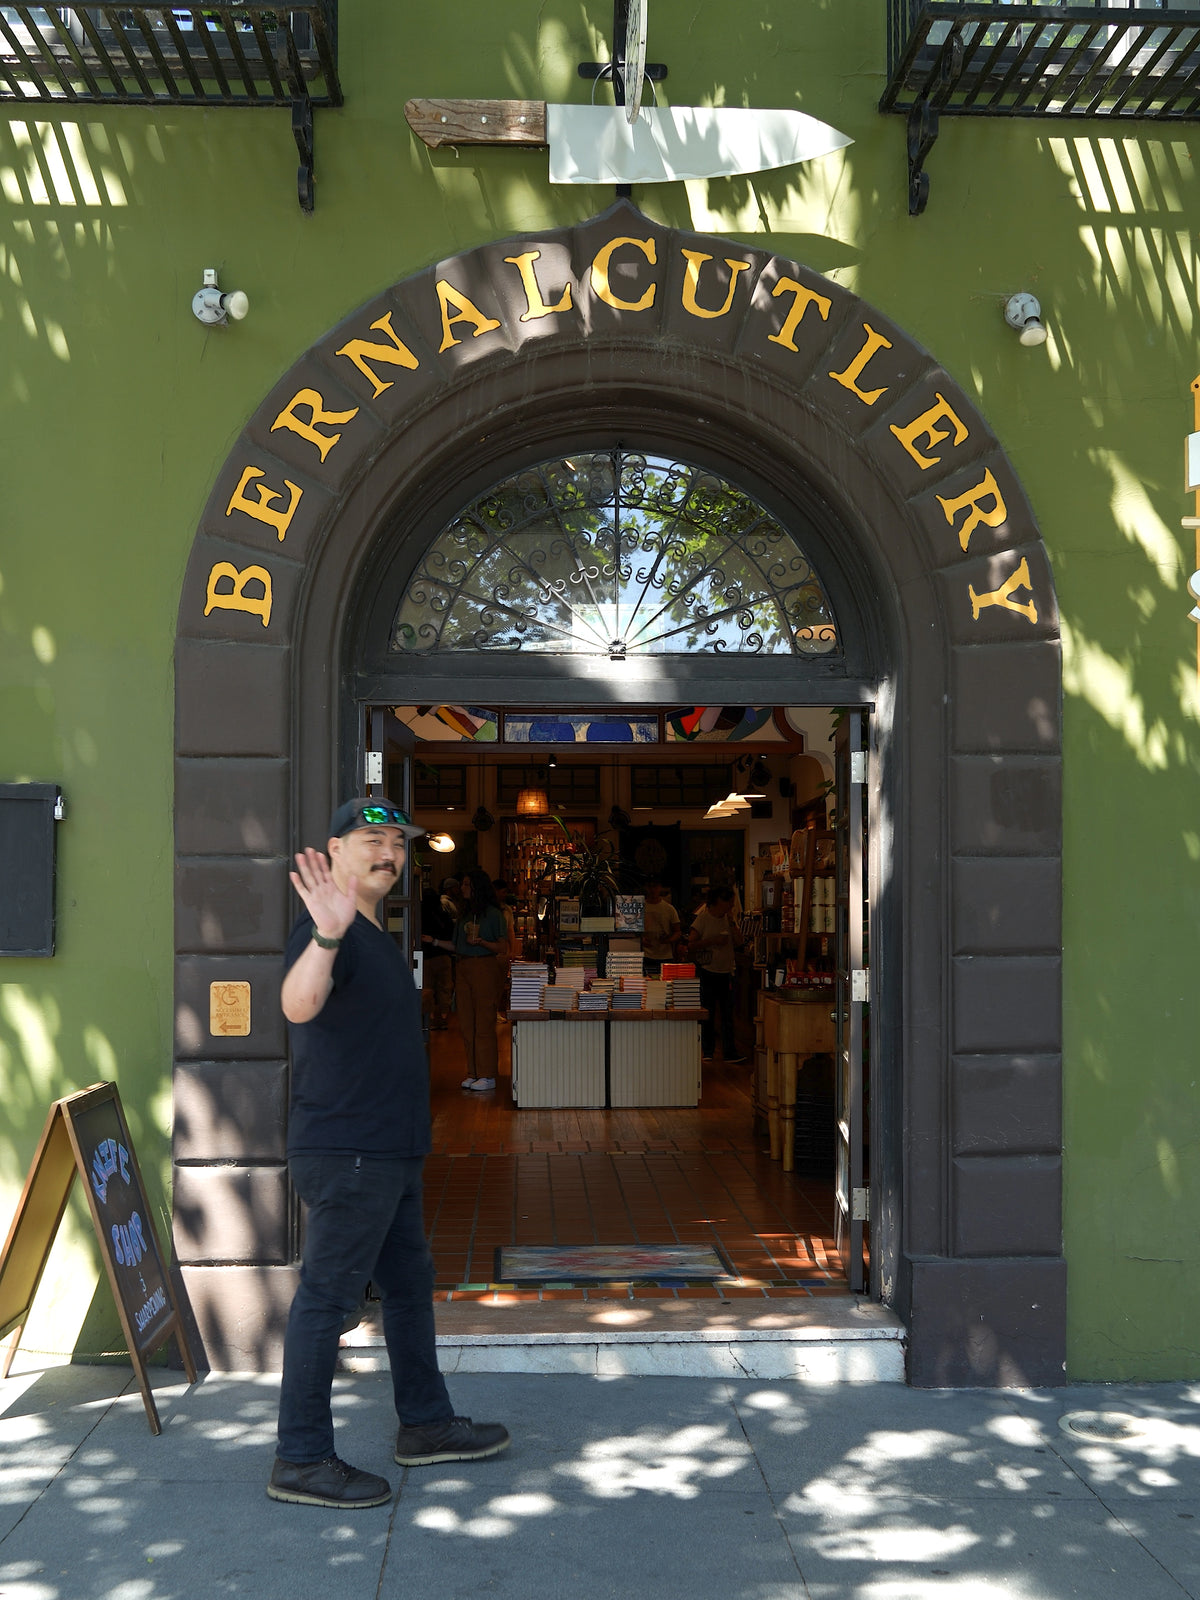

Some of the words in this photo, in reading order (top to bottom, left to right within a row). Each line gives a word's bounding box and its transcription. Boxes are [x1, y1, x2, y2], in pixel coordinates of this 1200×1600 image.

[203, 250, 573, 627] BERNAL
[592, 236, 1039, 624] CUTLERY
[91, 1138, 131, 1205] KNIFE
[112, 1211, 148, 1267] SHOP
